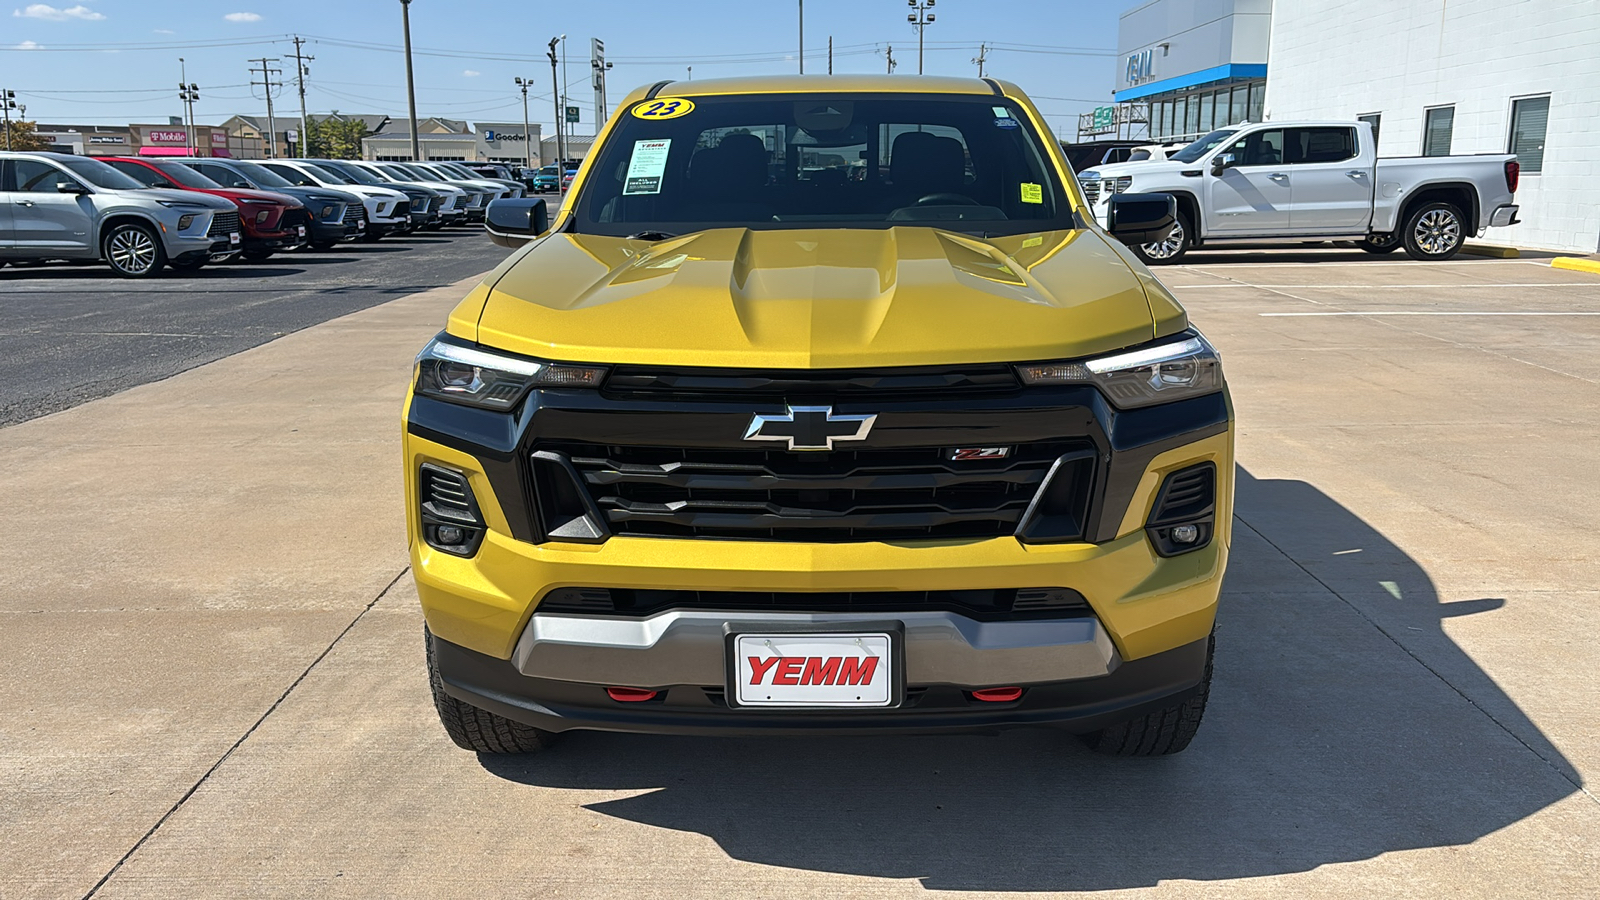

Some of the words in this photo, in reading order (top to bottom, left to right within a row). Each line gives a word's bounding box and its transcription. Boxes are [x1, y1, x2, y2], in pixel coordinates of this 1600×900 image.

[642, 101, 682, 116] 23
[160, 132, 185, 142] Mobile
[495, 133, 531, 141] Goodwl
[951, 447, 1008, 460] Z71
[747, 657, 880, 686] YEMM
